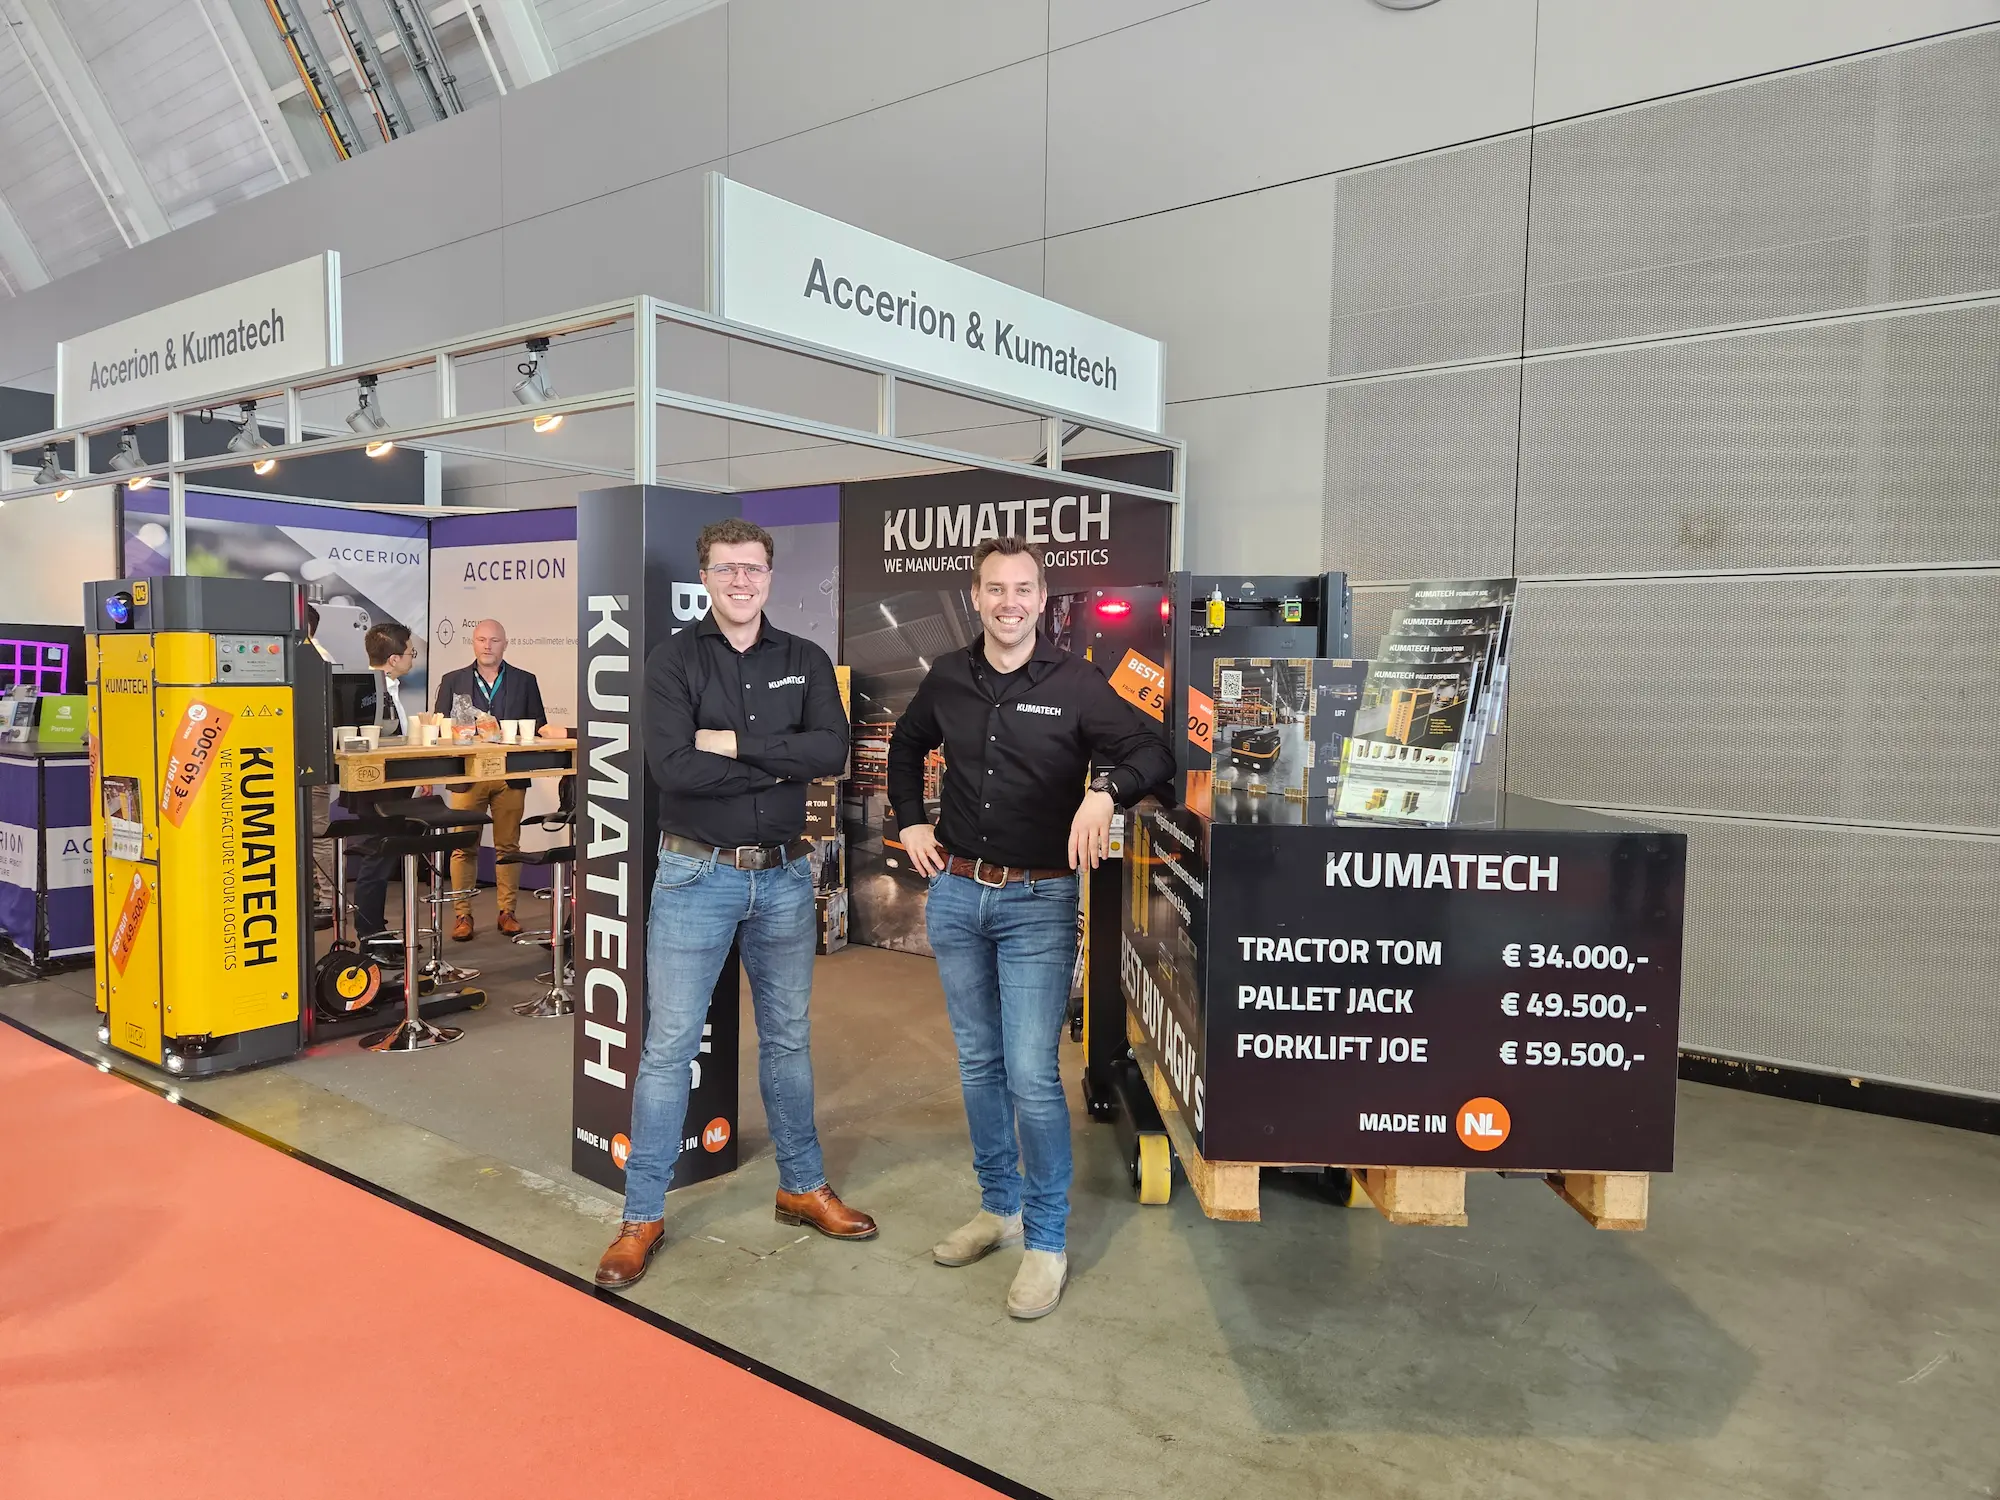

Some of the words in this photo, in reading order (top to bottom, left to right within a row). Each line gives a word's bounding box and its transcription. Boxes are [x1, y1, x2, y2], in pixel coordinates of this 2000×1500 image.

[803, 257, 955, 343] Accerion
[965, 310, 985, 352] &
[994, 318, 1118, 391] Kumatech
[90, 348, 159, 392] Accerion
[165, 338, 177, 369] &
[183, 308, 284, 367] Kumatech
[884, 494, 1110, 551] KUMATECH
[328, 547, 420, 565] ACCERION
[464, 558, 566, 582] ACCERION
[884, 558, 902, 573] WE
[905, 555, 974, 572] MANUFACTU
[1043, 549, 1109, 568] OGISTICS
[1415, 590, 1455, 598] KUMATECH
[1402, 618, 1444, 626] KUMATECH
[1389, 644, 1430, 652] KUMATECH
[1128, 658, 1160, 682] BEST
[1374, 671, 1415, 679] KUMATECH
[105, 679, 148, 694] KUMATECH
[1138, 686, 1152, 701] €
[1016, 702, 1062, 716] KUMATECH
[180, 717, 222, 785] 49.500,-
[220, 748, 232, 768] WE
[162, 780, 172, 810] BEST
[168, 756, 180, 781] BUY
[358, 769, 376, 778] EPAL
[174, 786, 188, 798] €
[220, 772, 235, 866] MANUFACTURE
[584, 594, 629, 1089] KUMATECH
[240, 747, 278, 968] KUMATECH
[1325, 850, 1560, 892] KUMATECH
[222, 869, 235, 904] YOUR
[112, 931, 122, 956] BEST
[120, 912, 128, 934] BUY
[224, 907, 236, 972] LOGISTICS
[1238, 936, 1369, 964] TRACTOR
[1377, 940, 1442, 966] TOM
[1502, 944, 1521, 968] €
[1528, 943, 1649, 974] 34.000,-
[1121, 930, 1142, 1009] BEST
[1142, 966, 1164, 1052] BUY
[1238, 986, 1340, 1012] PALLET
[1347, 988, 1413, 1014] JACK
[1500, 992, 1520, 1016] €
[1526, 992, 1647, 1022] 49.500,-
[1237, 1033, 1372, 1061] FORKLIFT
[1378, 1037, 1428, 1064] JOE
[1499, 1040, 1518, 1066] €
[1524, 1041, 1645, 1071] 59.500,-
[686, 1136, 698, 1150] IN
[706, 1128, 726, 1146] NL
[1359, 1113, 1420, 1134] MADE
[1424, 1114, 1446, 1134] IN
[1464, 1112, 1503, 1136] NL
[576, 1127, 598, 1148] MADE
[600, 1138, 608, 1152] IN
[614, 1141, 628, 1161] NL
